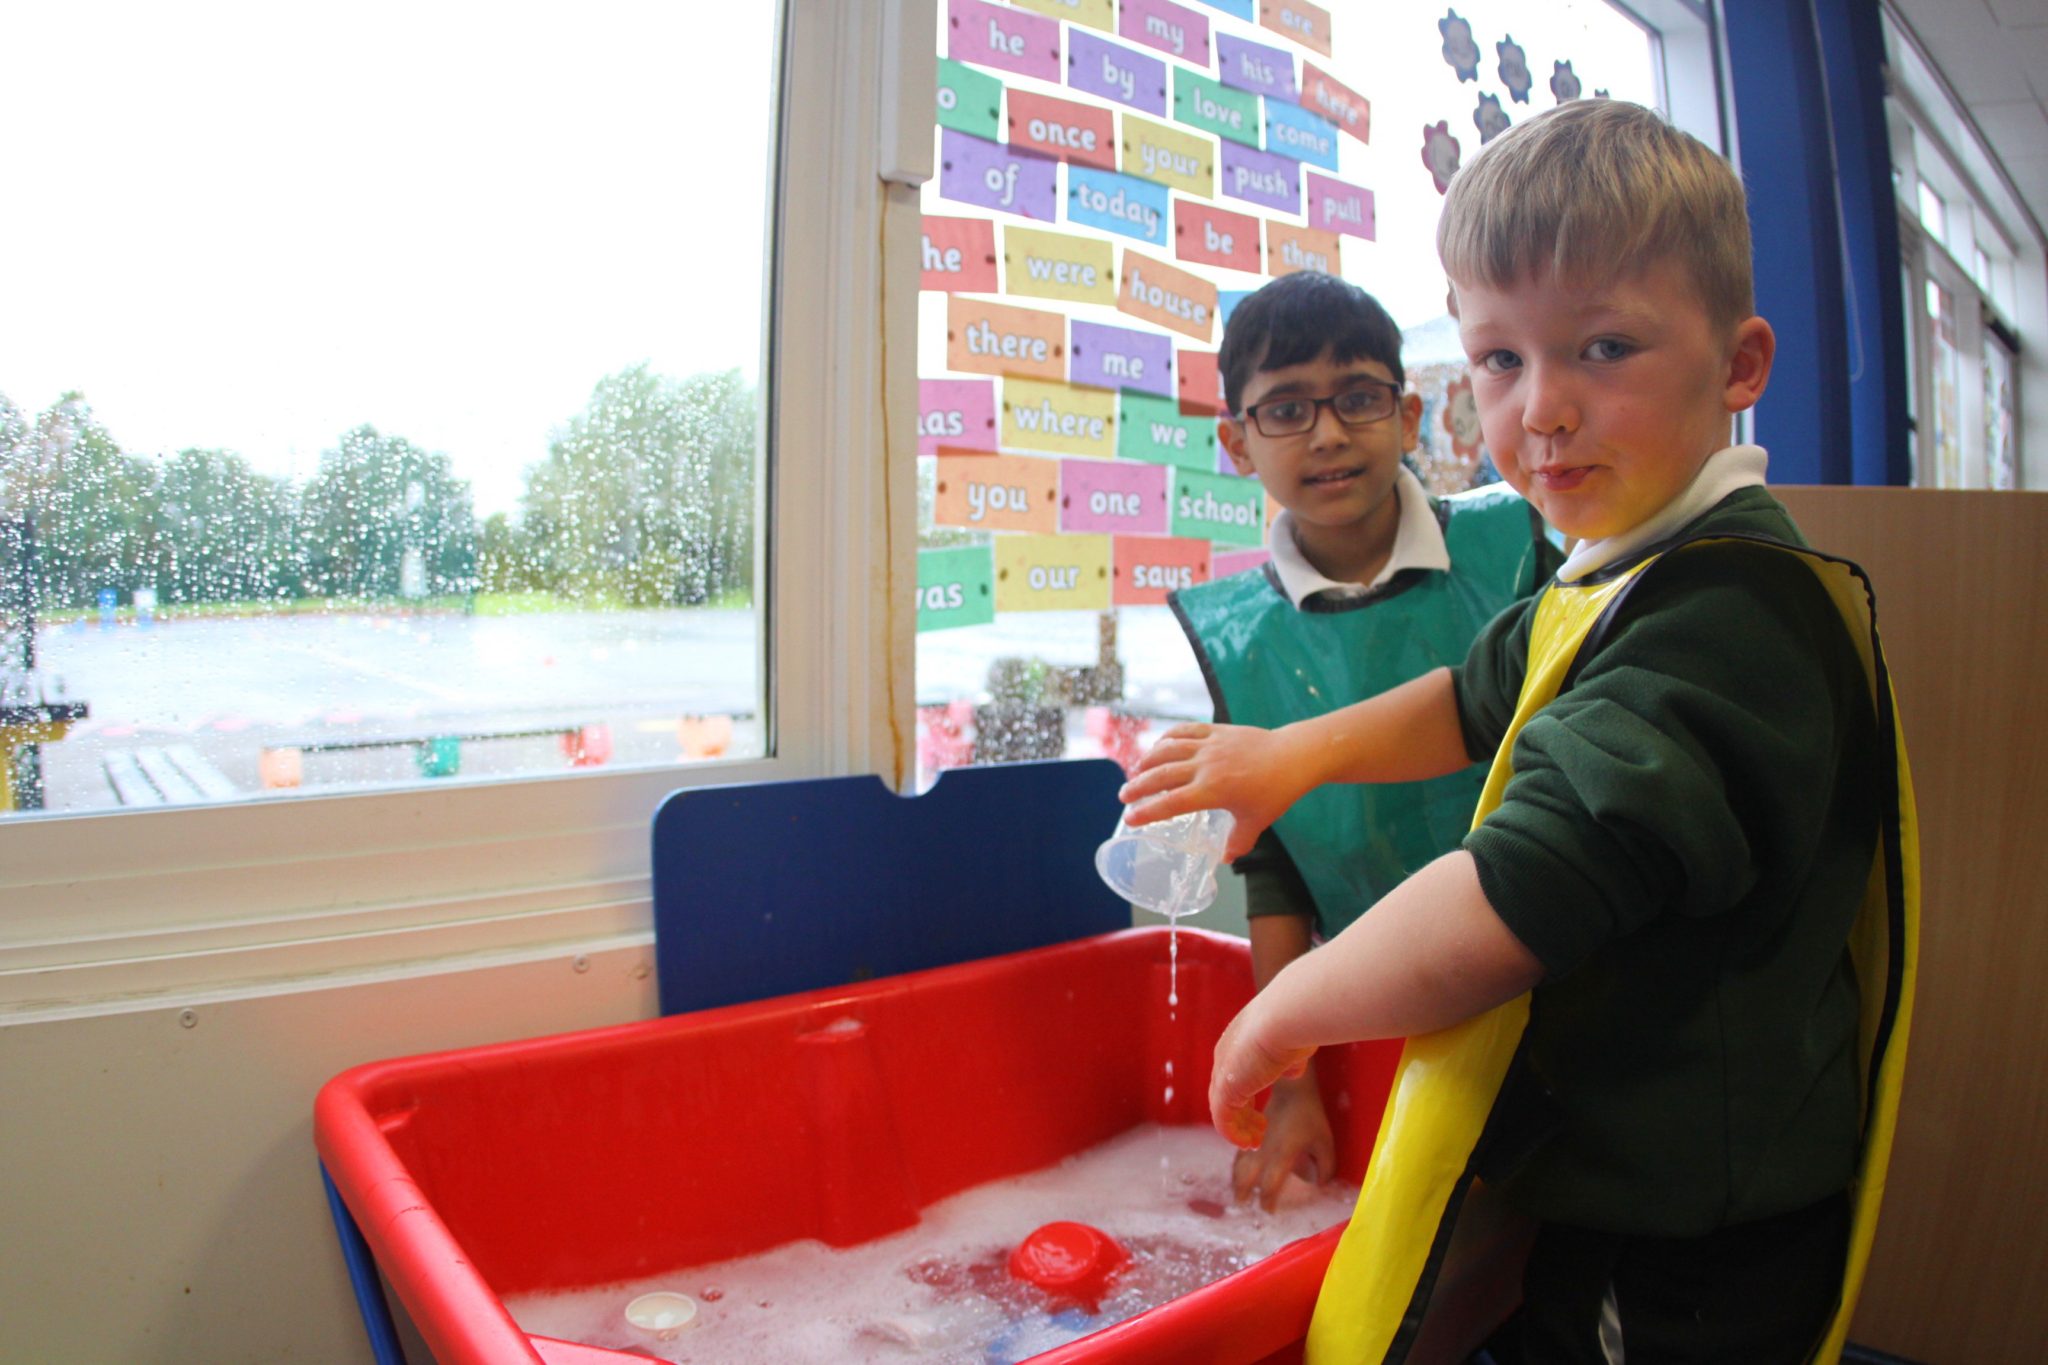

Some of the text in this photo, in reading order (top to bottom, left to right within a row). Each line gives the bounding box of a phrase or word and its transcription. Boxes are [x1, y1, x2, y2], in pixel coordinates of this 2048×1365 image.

[989, 18, 1025, 56] he
[1146, 15, 1185, 54] my
[1280, 8, 1313, 36] are
[1102, 53, 1135, 101] by
[1241, 52, 1274, 85] his
[1193, 86, 1243, 129] love
[1028, 118, 1096, 150] once
[1276, 122, 1329, 156] come
[1141, 139, 1199, 174] your
[985, 163, 1020, 206] of
[1233, 164, 1289, 198] push
[1077, 182, 1158, 237] today
[1322, 196, 1362, 226] pull
[1204, 219, 1234, 255] be
[1026, 255, 1097, 287] were
[1281, 238, 1329, 273] they
[1130, 268, 1208, 325] house
[965, 318, 1048, 362] there
[1102, 352, 1144, 380] me
[918, 409, 964, 436] as
[1013, 399, 1104, 440] where
[1150, 422, 1188, 448] we
[967, 482, 1029, 522] you
[1088, 489, 1141, 516] one
[1178, 490, 1258, 527] school
[1028, 564, 1080, 590] our
[1132, 563, 1192, 590] says
